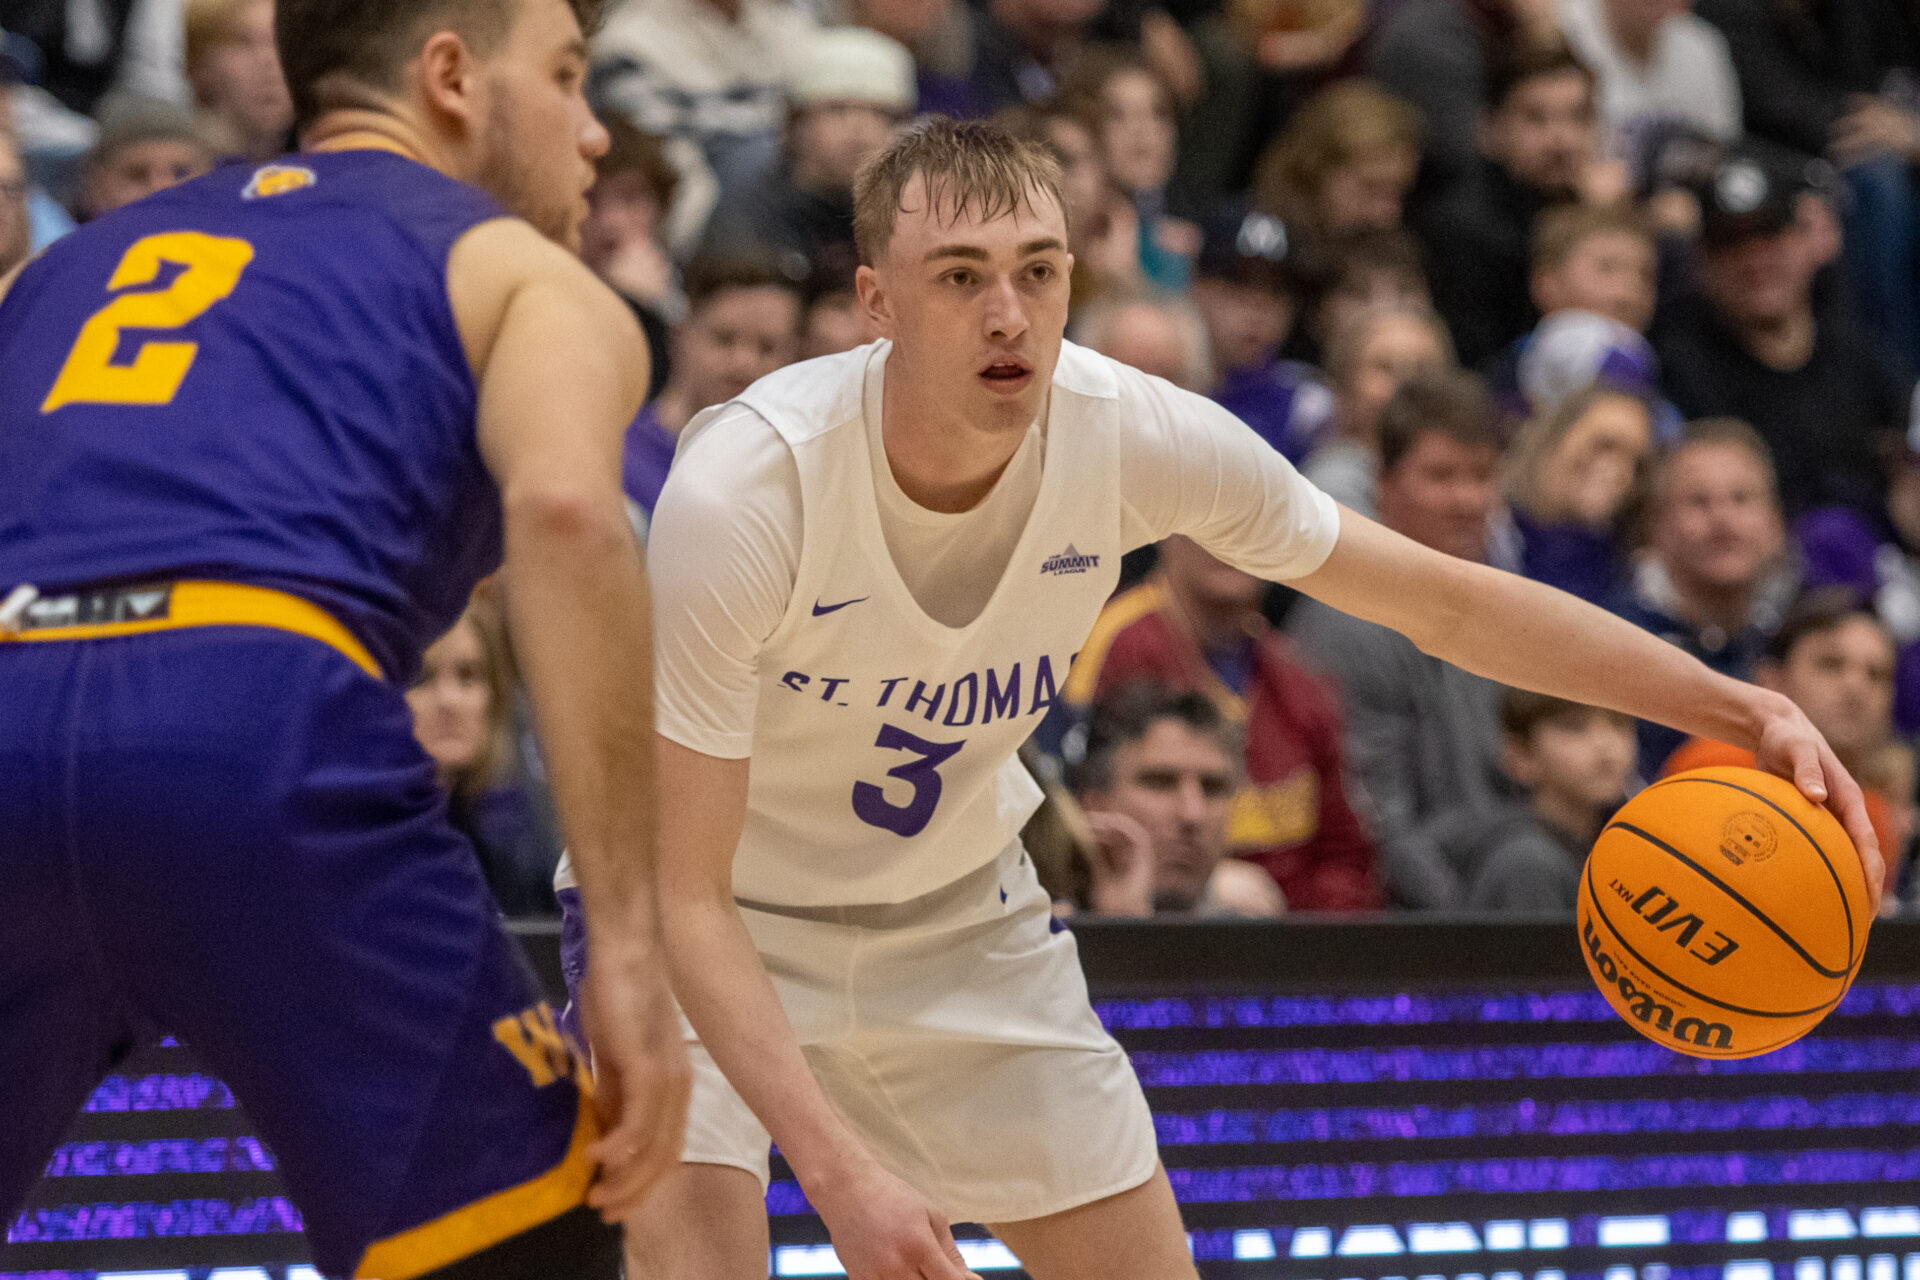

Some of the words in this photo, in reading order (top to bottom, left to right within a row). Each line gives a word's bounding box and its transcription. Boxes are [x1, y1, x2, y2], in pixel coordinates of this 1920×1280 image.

[40, 230, 255, 414] 2
[1040, 555, 1100, 574] SUMMIT
[777, 671, 850, 709] ST.
[876, 651, 1079, 726] THOMA
[852, 723, 968, 838] 3
[1608, 878, 1635, 903] NXT
[1630, 885, 1740, 967] EVO
